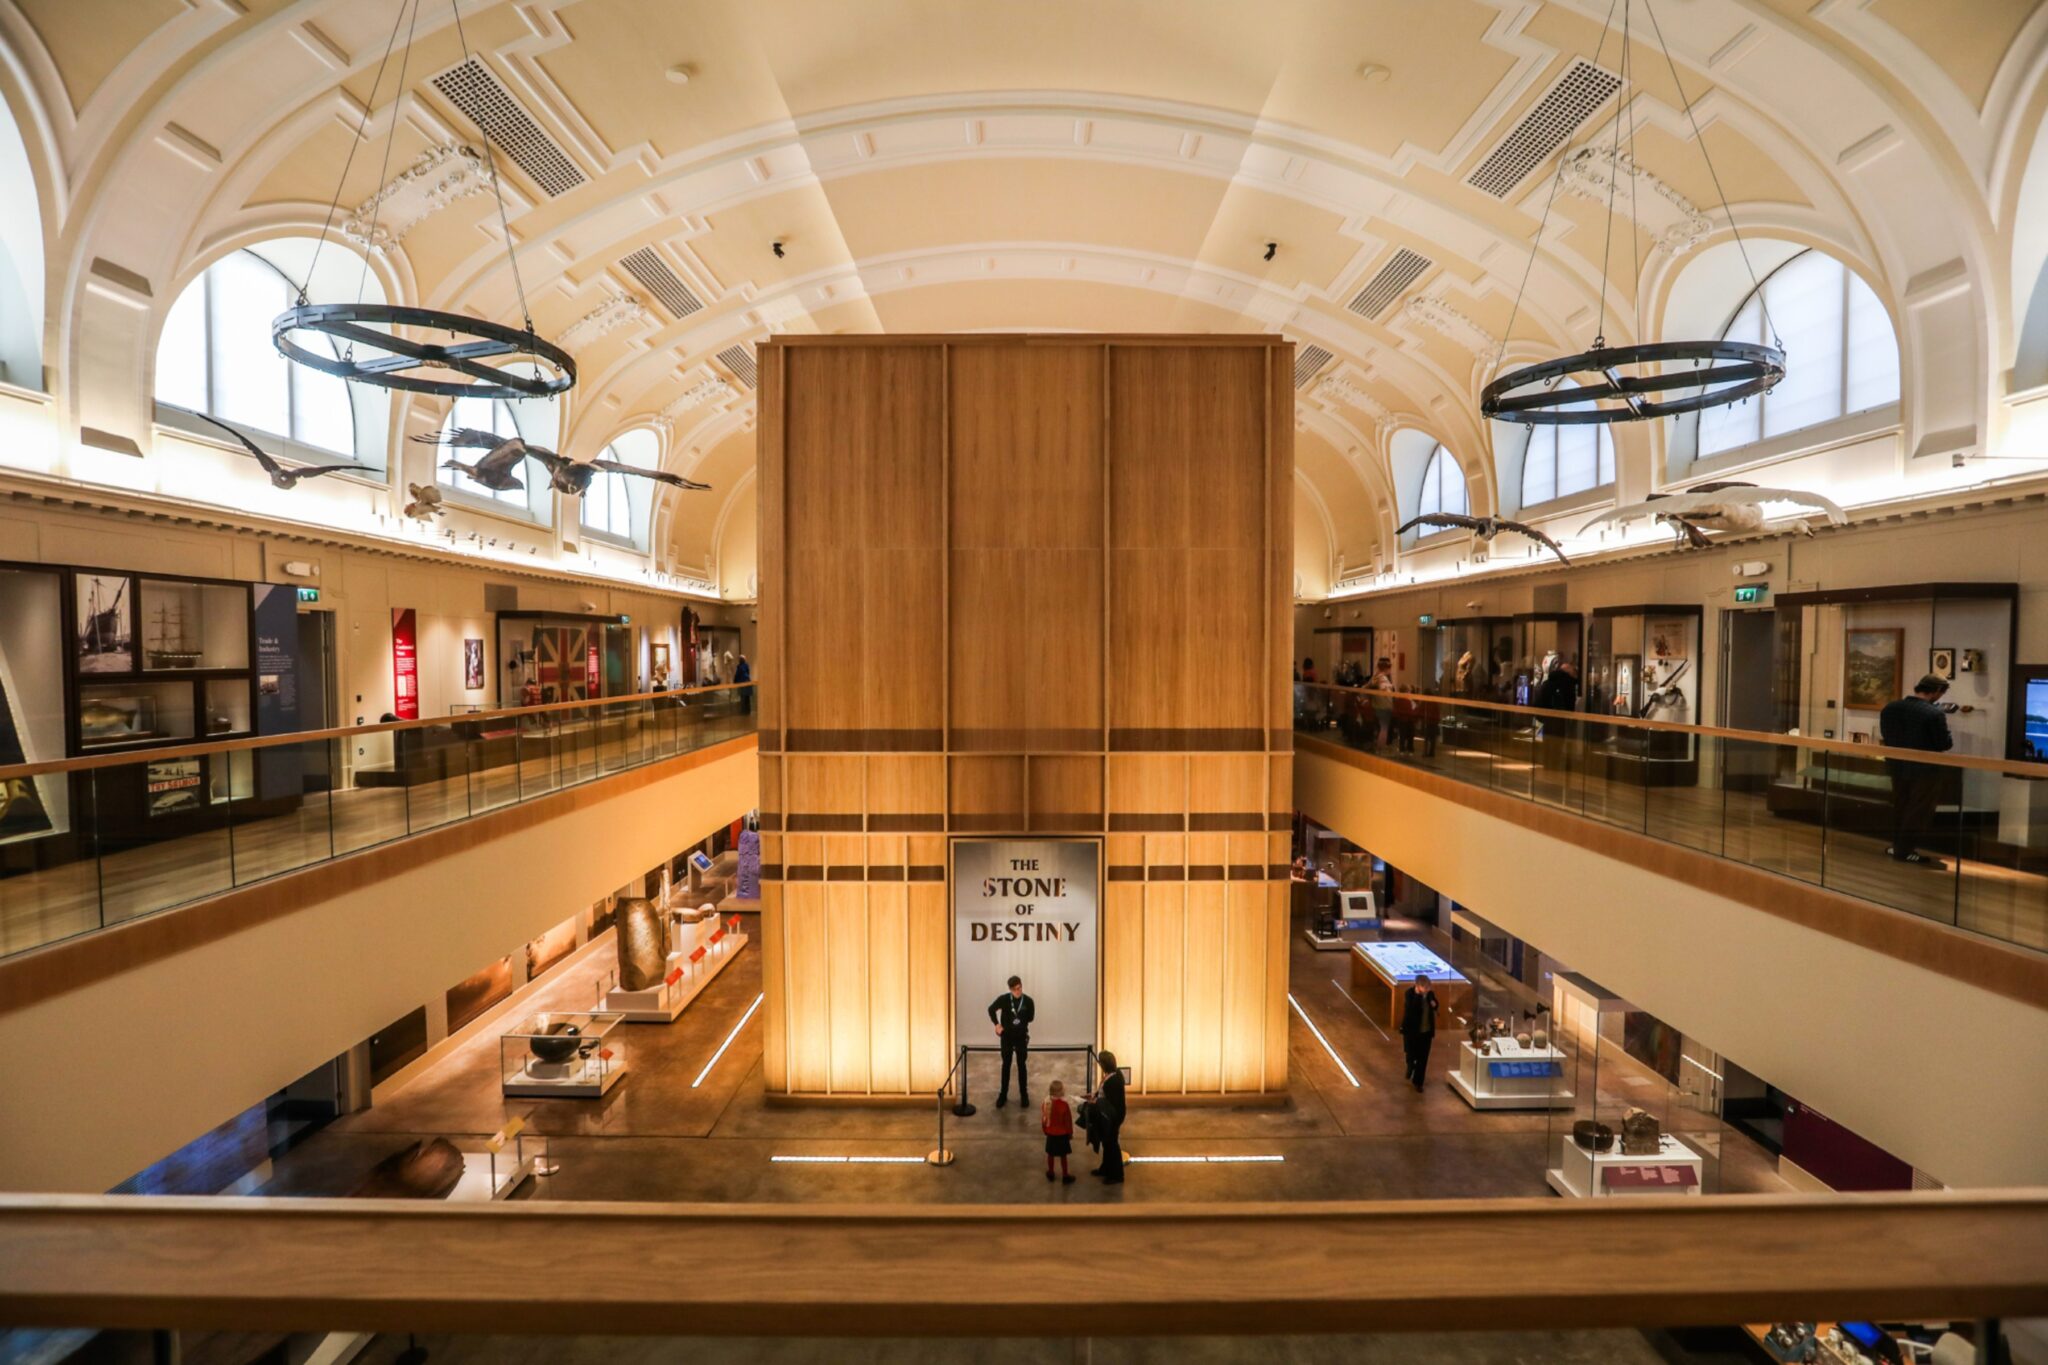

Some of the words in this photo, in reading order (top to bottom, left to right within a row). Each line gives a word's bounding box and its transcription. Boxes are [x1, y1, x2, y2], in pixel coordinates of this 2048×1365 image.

[1010, 858, 1039, 871] THE
[983, 877, 1066, 897] STONE
[1015, 904, 1035, 915] OF
[970, 922, 1080, 942] DESTINY
